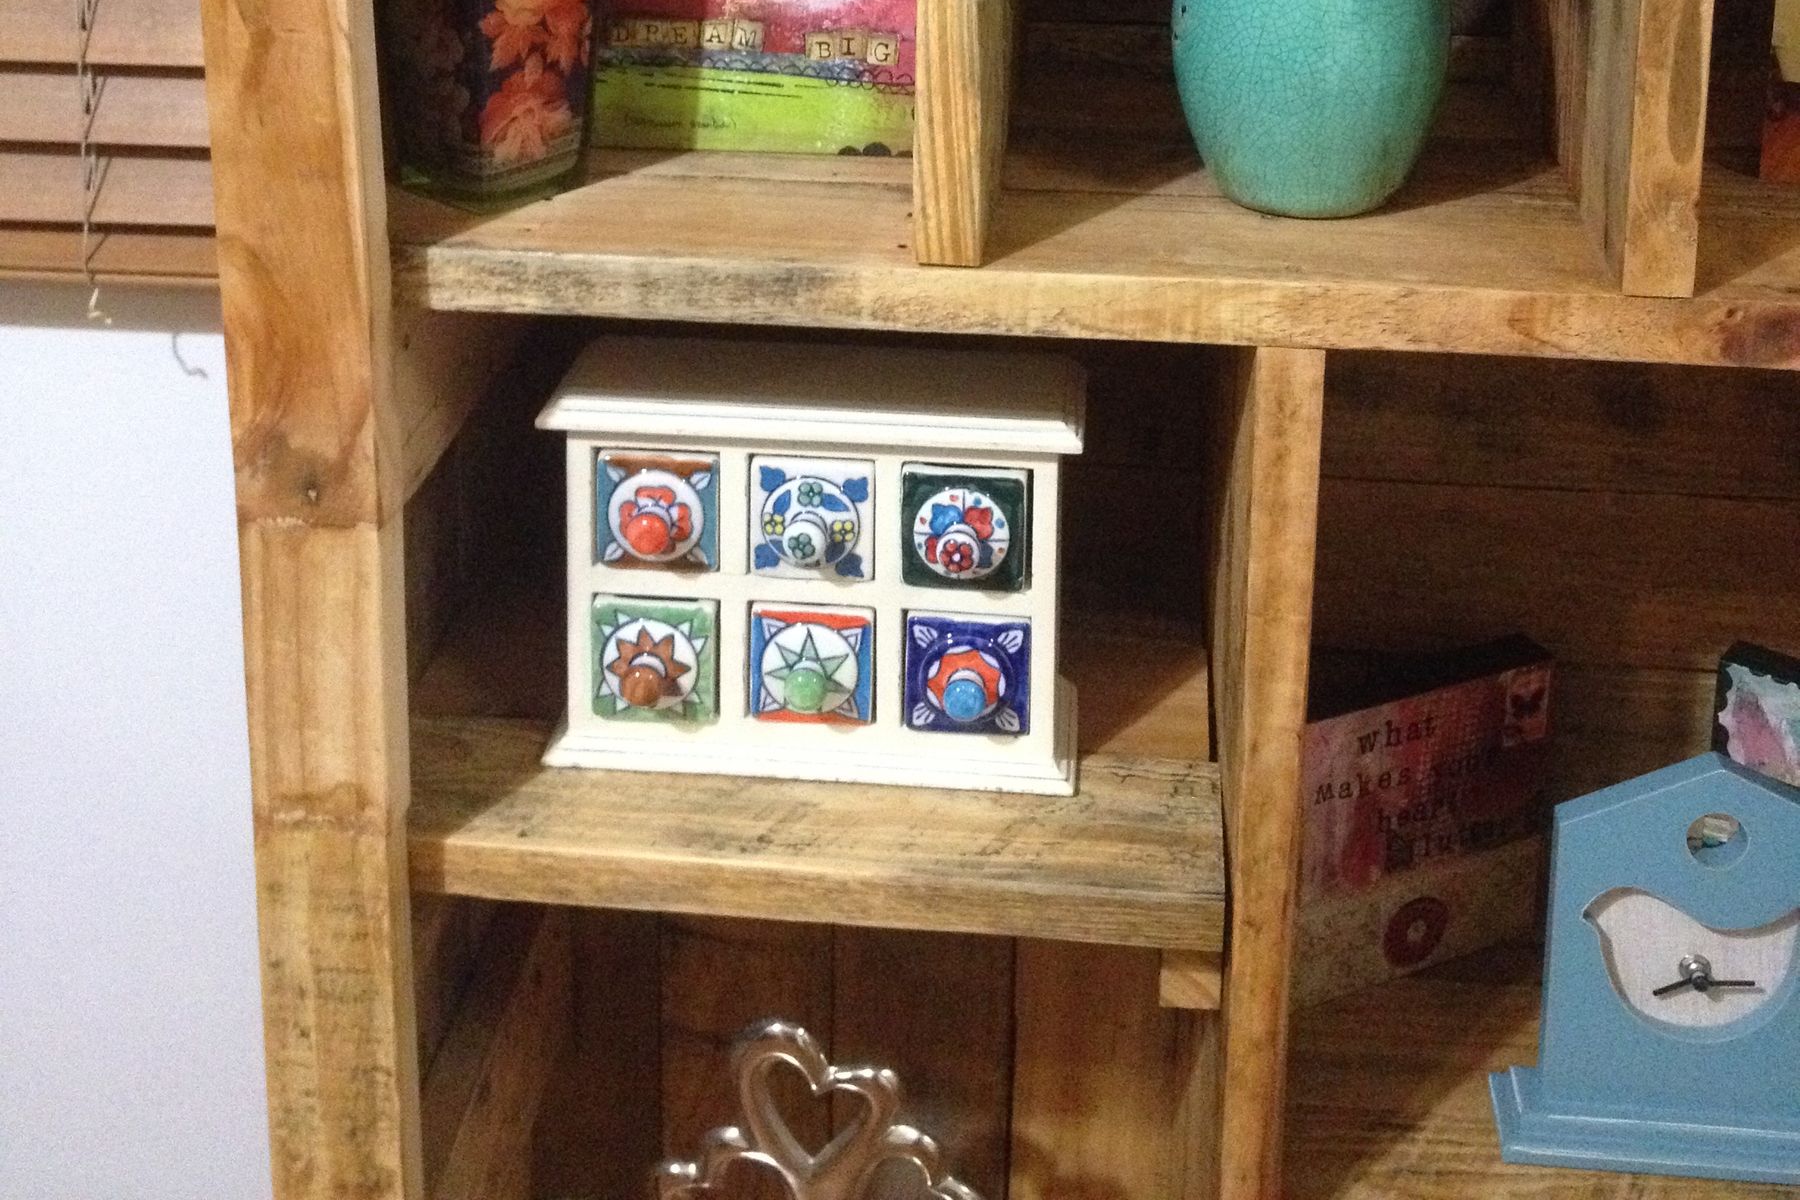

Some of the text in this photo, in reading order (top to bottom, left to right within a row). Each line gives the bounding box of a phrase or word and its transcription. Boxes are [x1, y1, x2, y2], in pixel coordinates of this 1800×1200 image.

[613, 22, 892, 63] DREAM BIG
[1357, 716, 1437, 754] what
